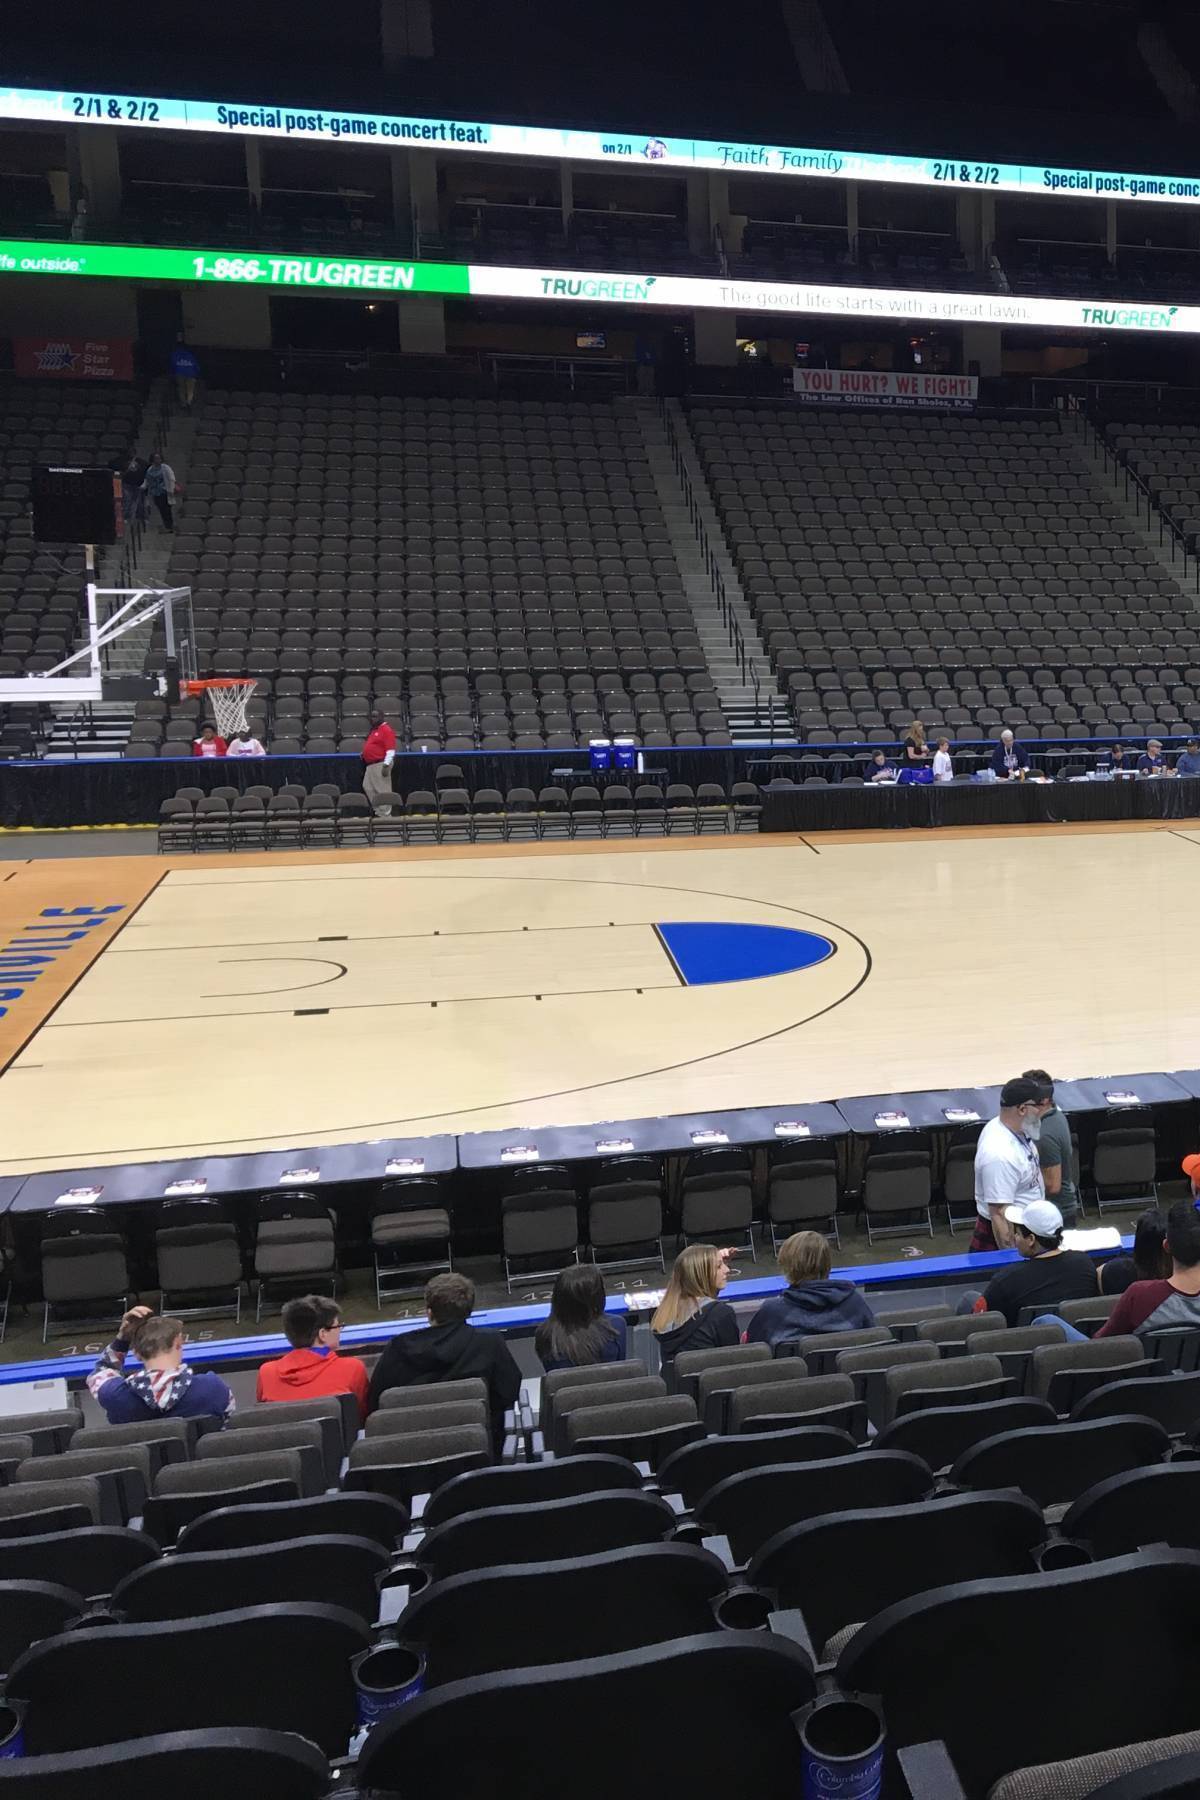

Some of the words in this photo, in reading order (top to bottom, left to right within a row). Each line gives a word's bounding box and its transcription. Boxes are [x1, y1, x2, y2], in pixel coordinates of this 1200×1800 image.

[73, 97, 102, 117] 2/1
[108, 99, 122, 119] &
[127, 101, 160, 122] 2/2
[217, 106, 281, 129] Special
[286, 113, 377, 137] post-game
[381, 121, 446, 140] concert
[449, 123, 488, 144] feat.
[602, 143, 616, 154] on
[617, 143, 632, 156] 2/1
[718, 146, 769, 166] Faith
[778, 150, 843, 174] Family
[933, 162, 956, 181] 2/1
[959, 164, 971, 182] &
[975, 166, 999, 184] 2/2
[1044, 170, 1092, 190] Special
[1096, 176, 1166, 196] post-game
[541, 277, 651, 299] TRUGREEN
[719, 287, 751, 303] The
[757, 291, 800, 307] good
[806, 292, 831, 307] life
[836, 296, 883, 311] starts
[888, 299, 923, 313] with
[928, 303, 938, 313] a
[943, 304, 983, 317] great
[989, 304, 1032, 319] lawn.
[1081, 308, 1172, 328] TRUGREEN
[85, 342, 109, 351] Five
[83, 354, 110, 364] Star
[83, 366, 114, 376] Pizza
[801, 371, 833, 391] YOU
[839, 373, 889, 393] HURT?
[896, 377, 919, 394] WE
[924, 378, 972, 396] FIGHT!
[801, 393, 819, 402] The
[882, 396, 894, 404] of
